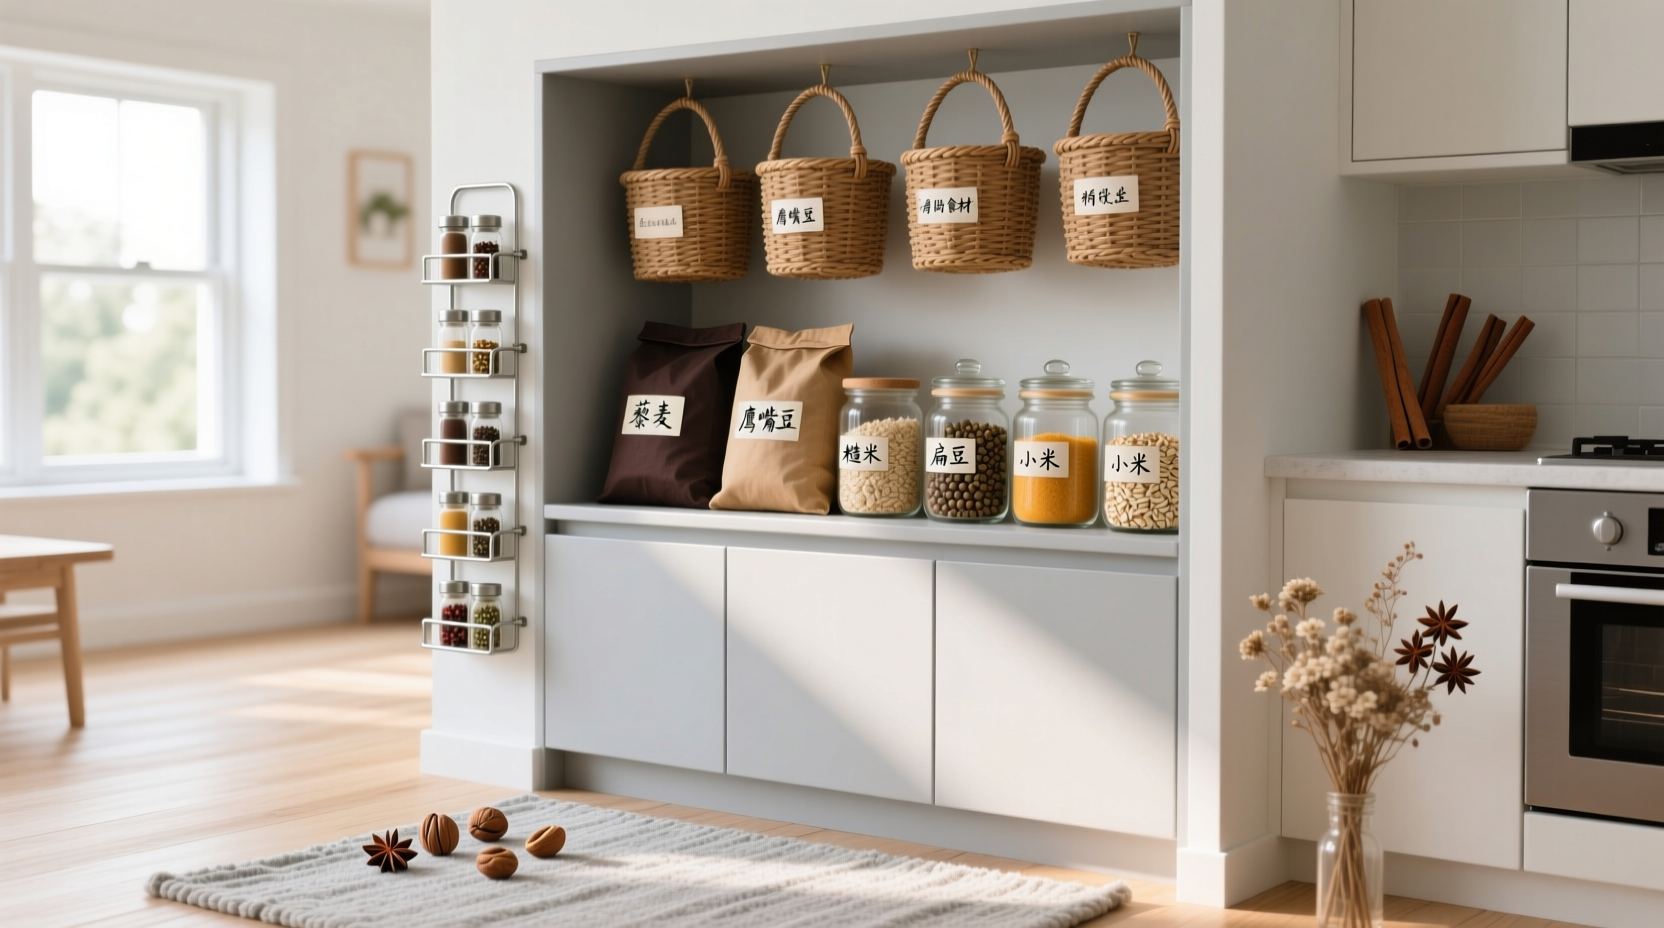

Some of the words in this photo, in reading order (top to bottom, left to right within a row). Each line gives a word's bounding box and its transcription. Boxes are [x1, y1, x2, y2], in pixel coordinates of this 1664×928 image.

[629, 399, 672, 430] 藜麦
[738, 405, 797, 434] 鹰嘴豆
[842, 441, 882, 465] 糙米
[930, 442, 969, 467] 扁豆
[1019, 447, 1060, 471] 小米
[1111, 452, 1151, 476] 小米
